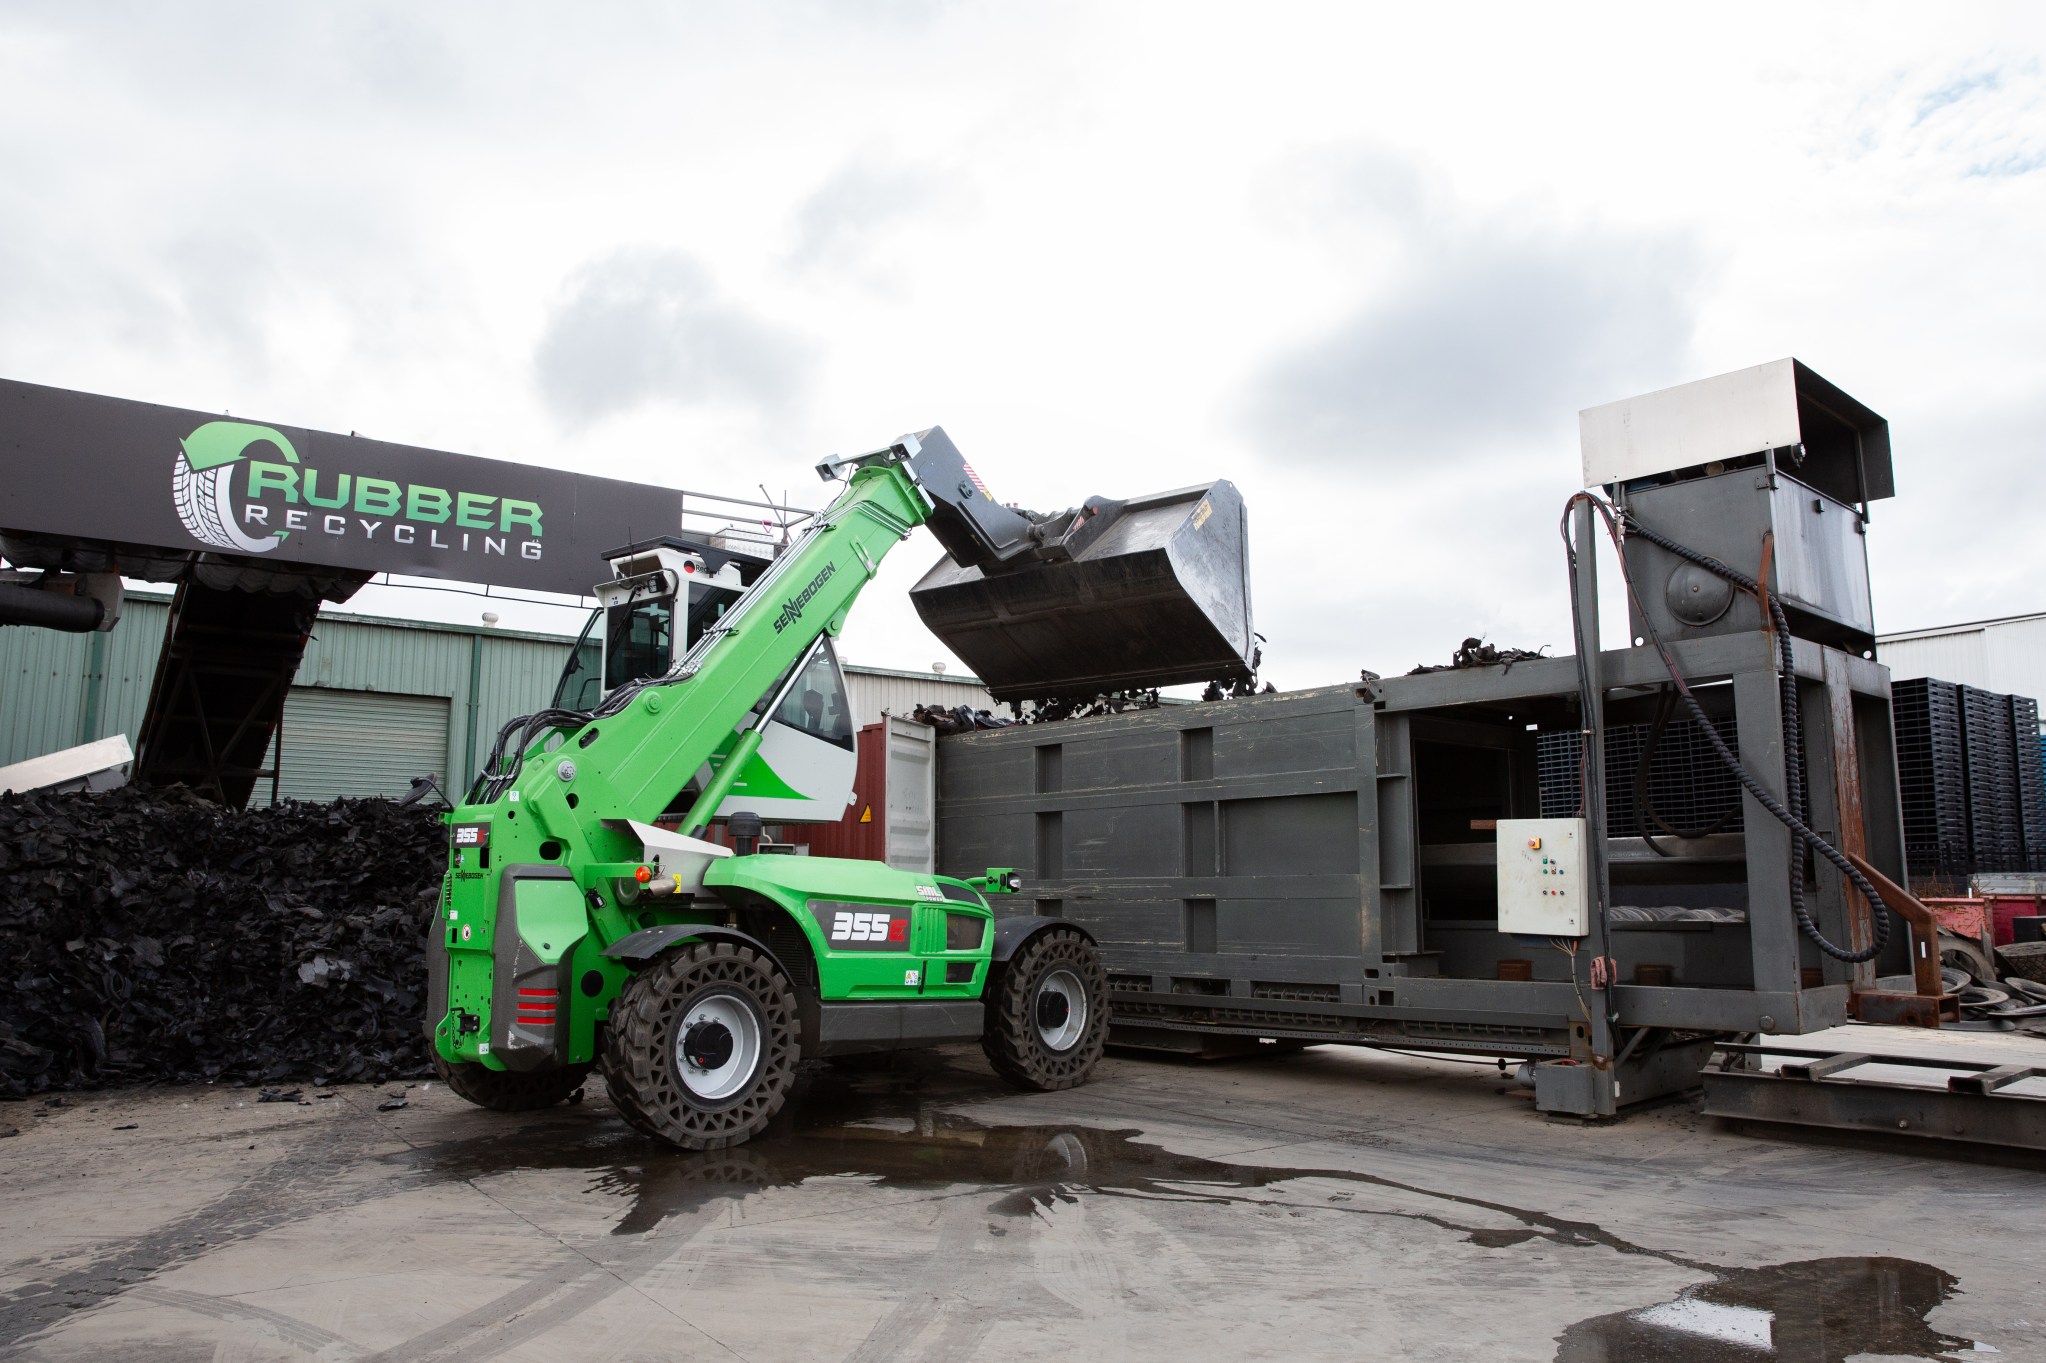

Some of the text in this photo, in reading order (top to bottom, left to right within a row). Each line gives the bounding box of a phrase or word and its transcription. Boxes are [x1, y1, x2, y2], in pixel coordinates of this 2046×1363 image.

[248, 460, 544, 537] RUBBER
[244, 504, 543, 560] RECYCLING
[773, 561, 836, 634] SENNEBOGEN
[456, 827, 486, 844] 355E
[831, 911, 908, 942] 355E
